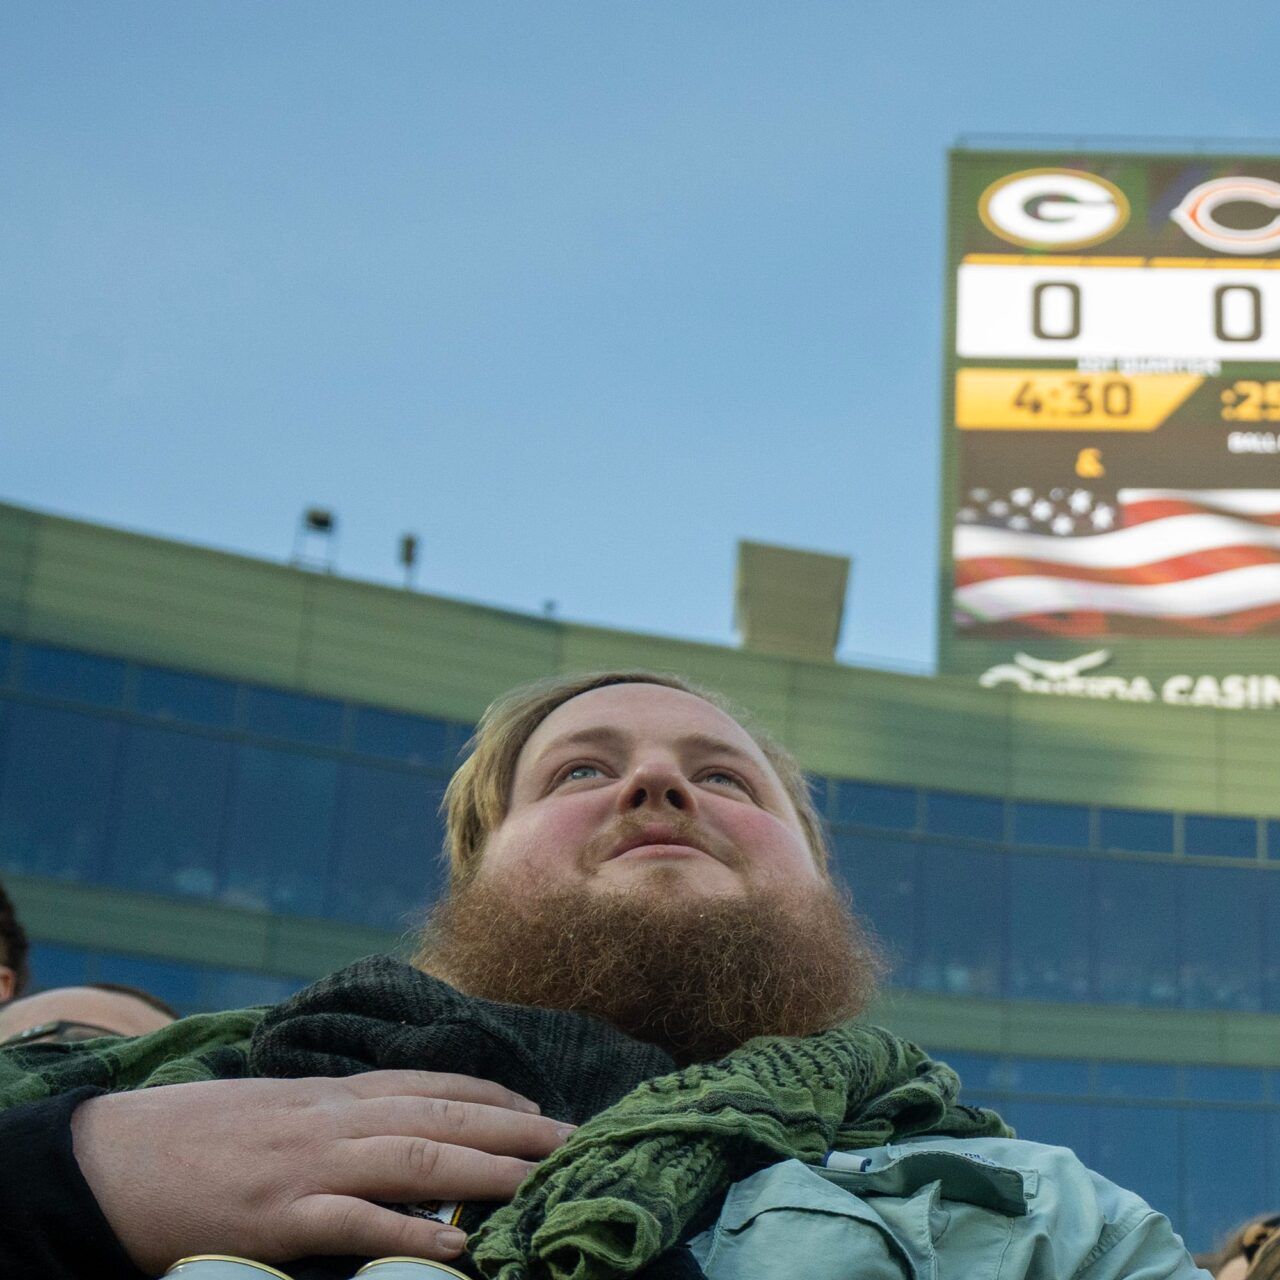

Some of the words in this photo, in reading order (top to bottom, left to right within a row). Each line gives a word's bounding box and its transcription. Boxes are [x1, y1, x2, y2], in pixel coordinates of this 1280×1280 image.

[980, 169, 1129, 249] G
[1031, 282, 1082, 342] 0
[1213, 283, 1263, 343] 0
[1011, 381, 1133, 418] 4:30
